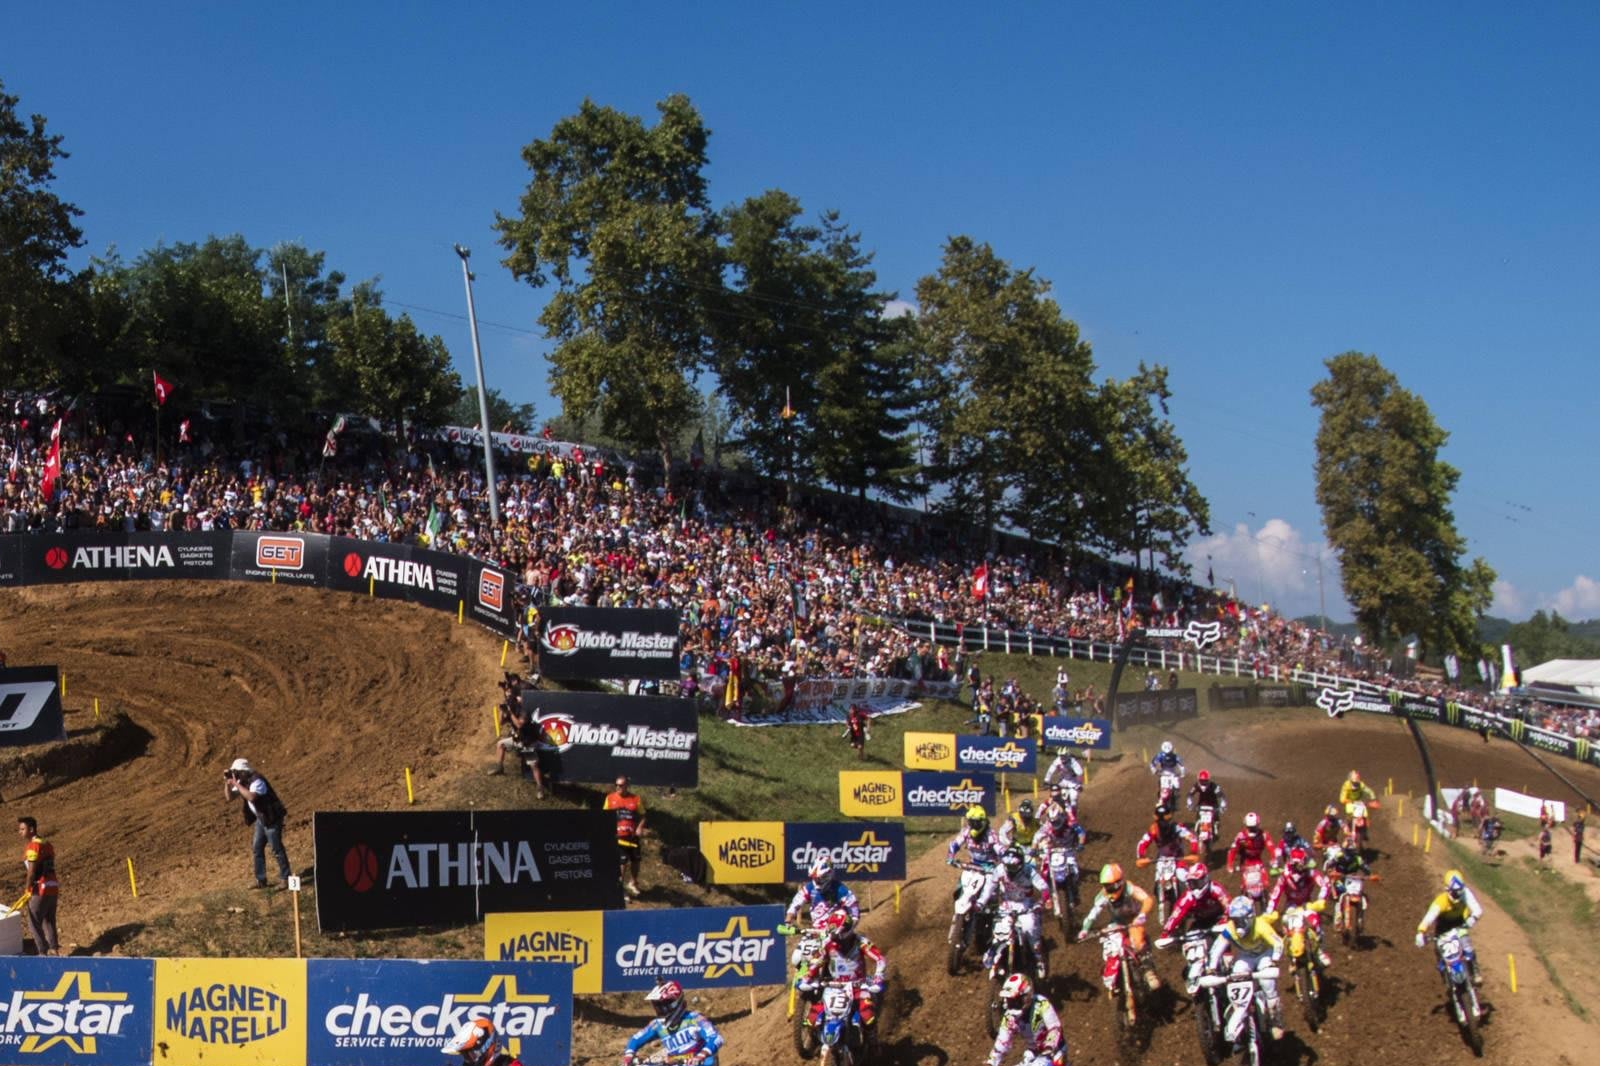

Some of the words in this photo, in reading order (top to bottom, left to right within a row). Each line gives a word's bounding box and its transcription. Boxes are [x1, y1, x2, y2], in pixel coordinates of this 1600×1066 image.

[72, 545, 175, 569] ATHENA
[261, 546, 298, 560] GET
[363, 556, 434, 591] ATHENA
[481, 579, 501, 598] GET
[575, 631, 678, 650] Moto-Master
[1146, 629, 1185, 637] HOLESHOT
[610, 649, 636, 658] Brake
[637, 649, 673, 659] Systems
[1353, 701, 1392, 712] HOLESHOT
[568, 722, 697, 750] Moto-Master
[1045, 723, 1103, 741] checkstar
[611, 746, 644, 758] Brake
[645, 747, 690, 761] Systems
[959, 746, 1028, 763] checkstar
[853, 783, 896, 798] MAGNETI
[853, 791, 896, 806] MARELLI
[908, 786, 986, 805] checkstar
[544, 841, 590, 851] CYLINDERS
[719, 837, 776, 857] MAGNETI
[792, 841, 892, 864] checkstar
[386, 840, 542, 889] ATHENA
[549, 854, 591, 865] GASKETS
[719, 849, 776, 868] MARELLI
[554, 868, 593, 880] PISTONS
[615, 934, 775, 968] checkstar
[622, 966, 659, 976] SERVICE
[661, 965, 705, 975] NETWORK
[167, 983, 287, 1019] MAGNETI
[1231, 986, 1251, 1001] 37
[829, 996, 849, 1009] 13
[325, 993, 558, 1036] checkstar
[167, 1008, 287, 1044] MARELLI
[335, 1037, 385, 1048] SERVICE
[390, 1037, 454, 1048] NETWORK
